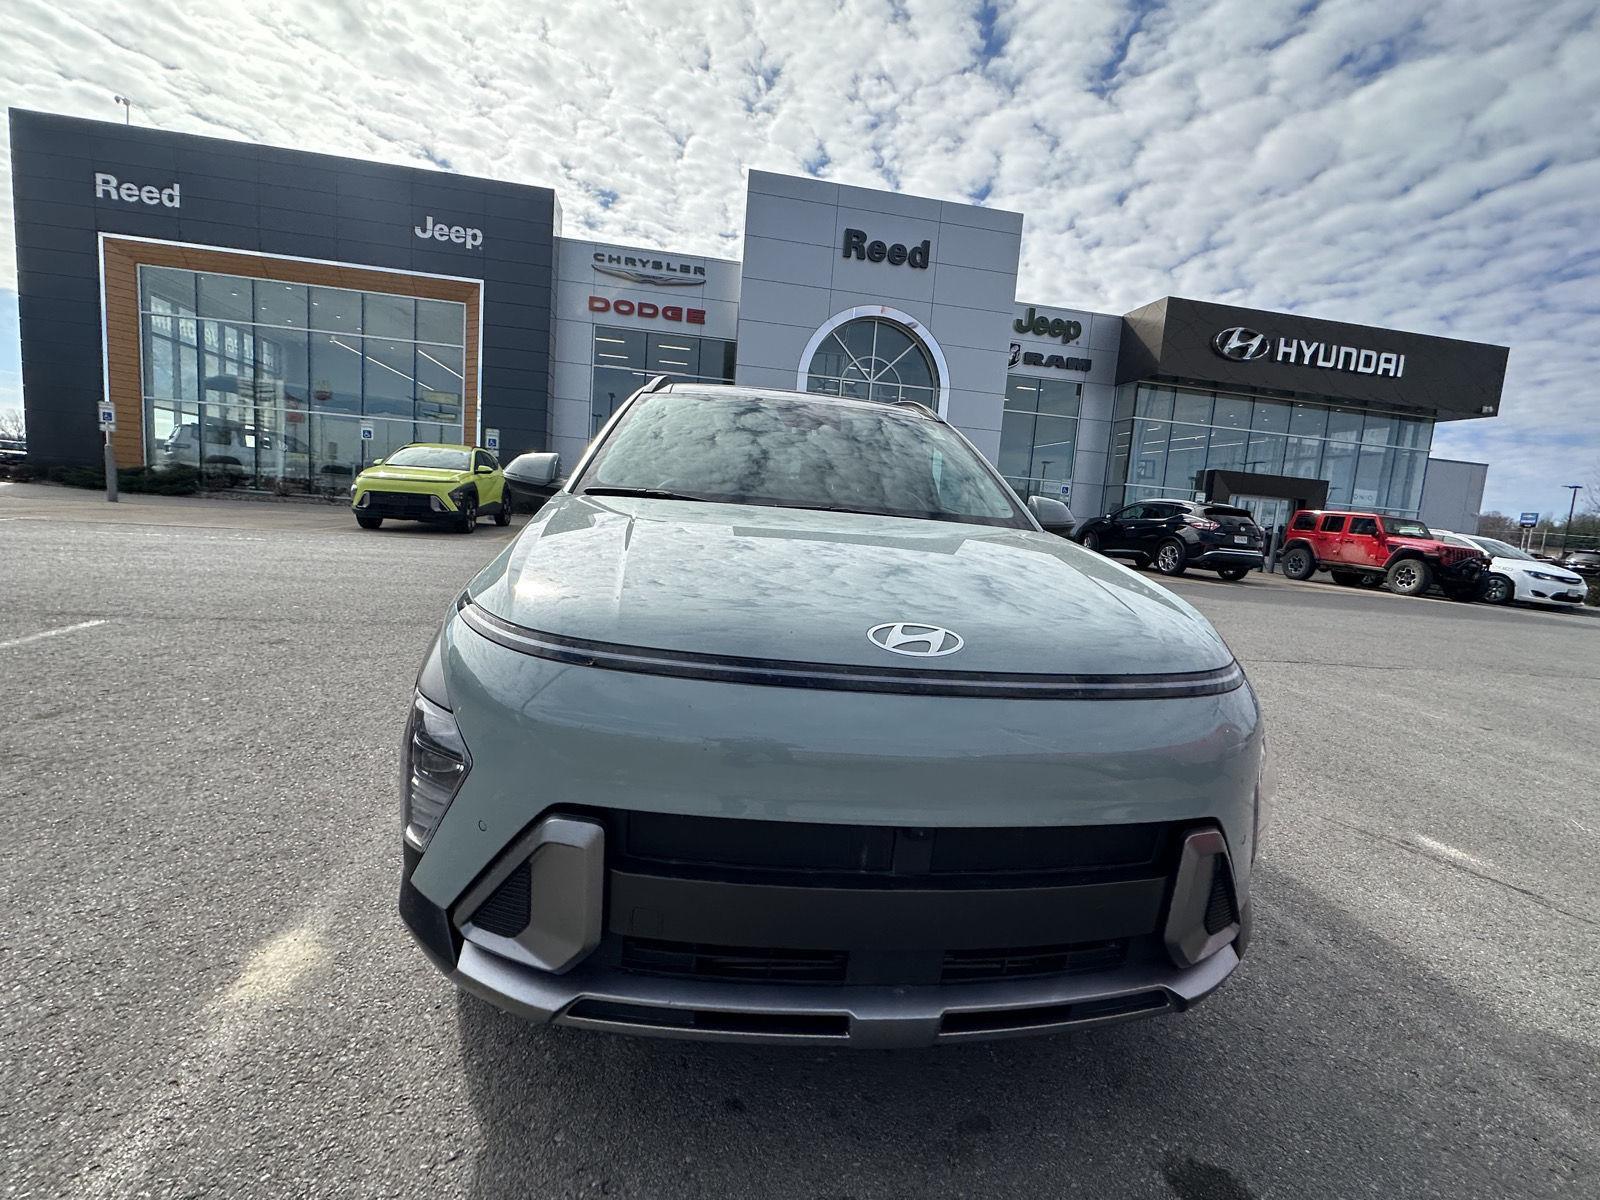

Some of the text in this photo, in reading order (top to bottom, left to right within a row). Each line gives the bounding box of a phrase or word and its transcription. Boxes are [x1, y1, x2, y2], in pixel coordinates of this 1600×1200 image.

[94, 172, 181, 209] Reed
[414, 215, 484, 250] Jeep
[842, 227, 931, 269] Reed
[593, 252, 706, 276] CHRYSLER
[588, 295, 706, 325] DODGE
[1013, 307, 1082, 344] Jeep
[1023, 351, 1092, 373] RAM
[1276, 337, 1406, 378] HYUNDAI
